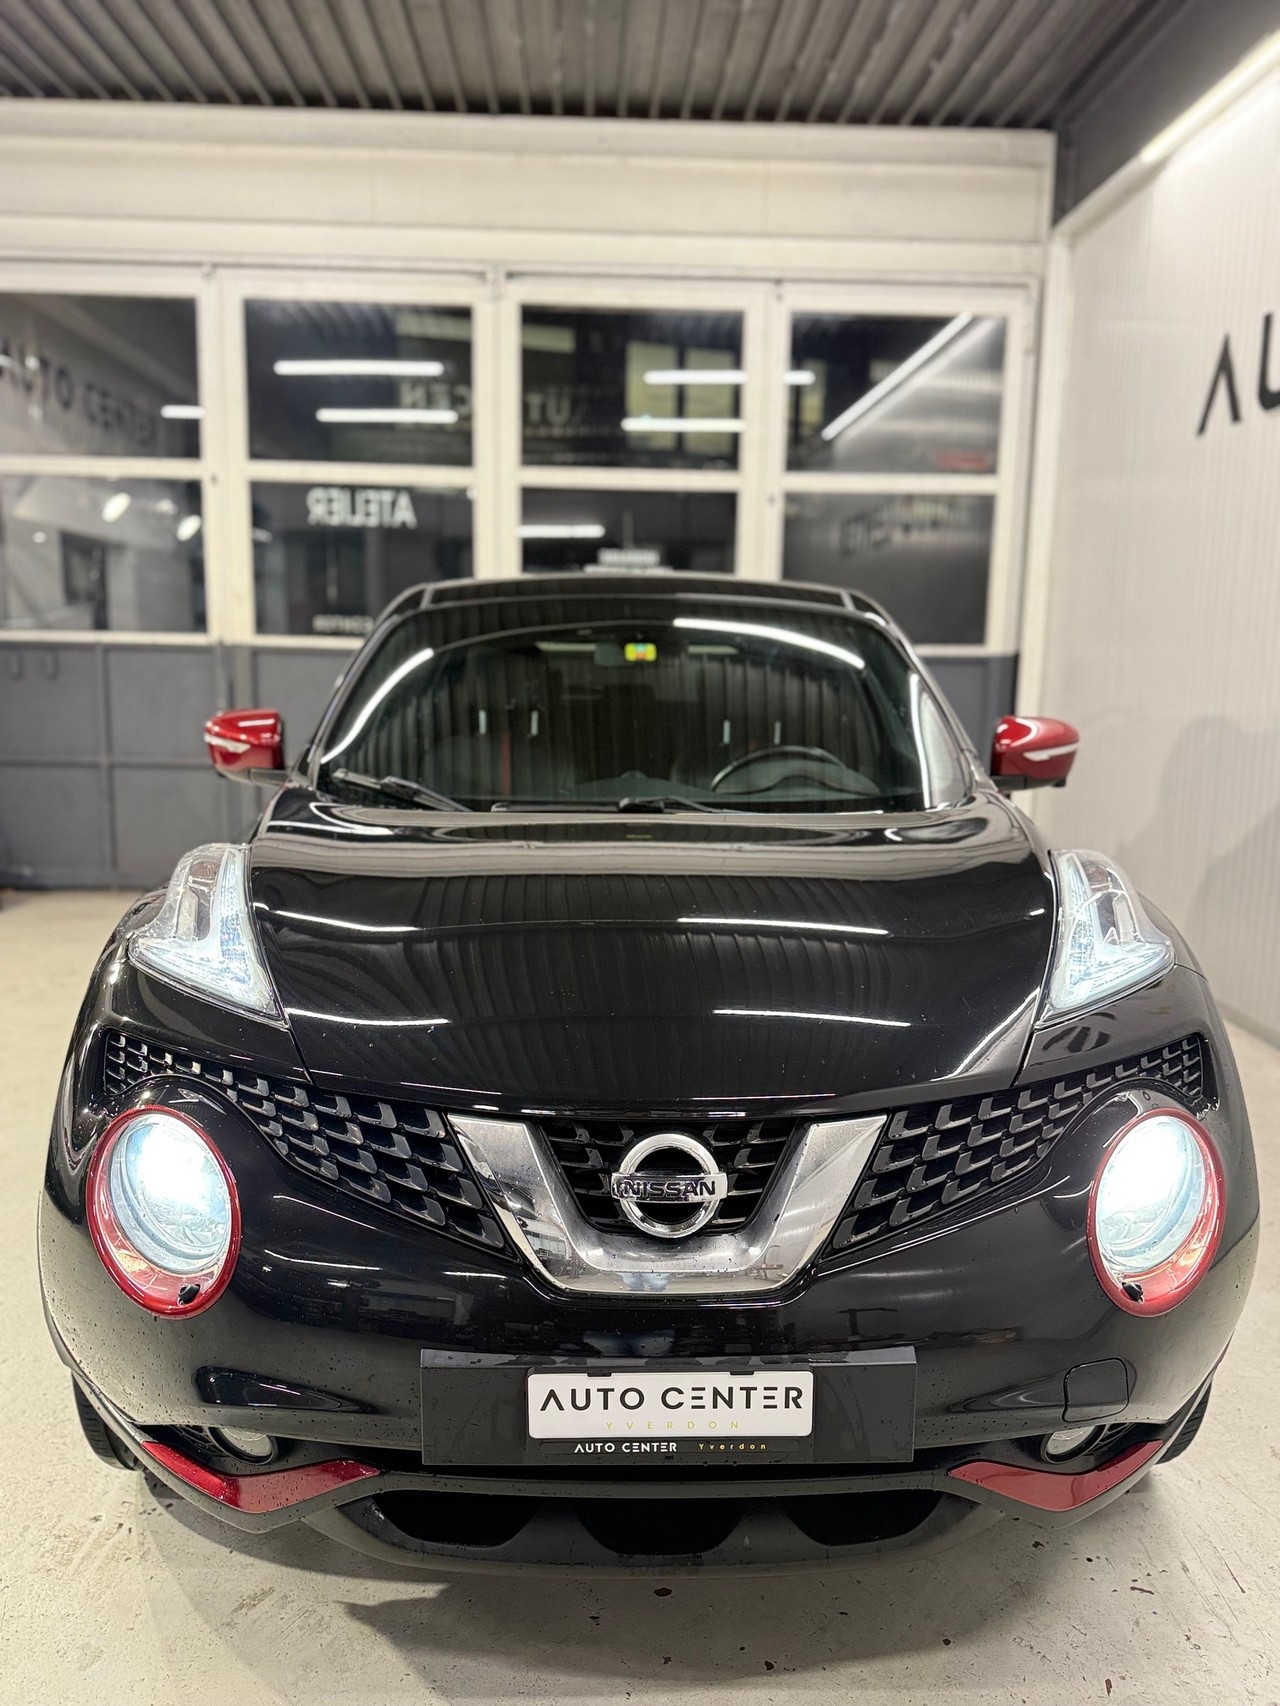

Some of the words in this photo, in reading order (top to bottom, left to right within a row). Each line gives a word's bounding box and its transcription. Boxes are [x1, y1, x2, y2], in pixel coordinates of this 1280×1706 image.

[623, 1179, 716, 1197] NISSAN
[540, 1386, 645, 1412] AUTO
[660, 1386, 803, 1411] CENTER
[605, 1420, 740, 1431] YVERDON
[574, 1442, 616, 1454] AUTO
[621, 1442, 677, 1454] CENTER
[698, 1442, 767, 1452] Yverdon
